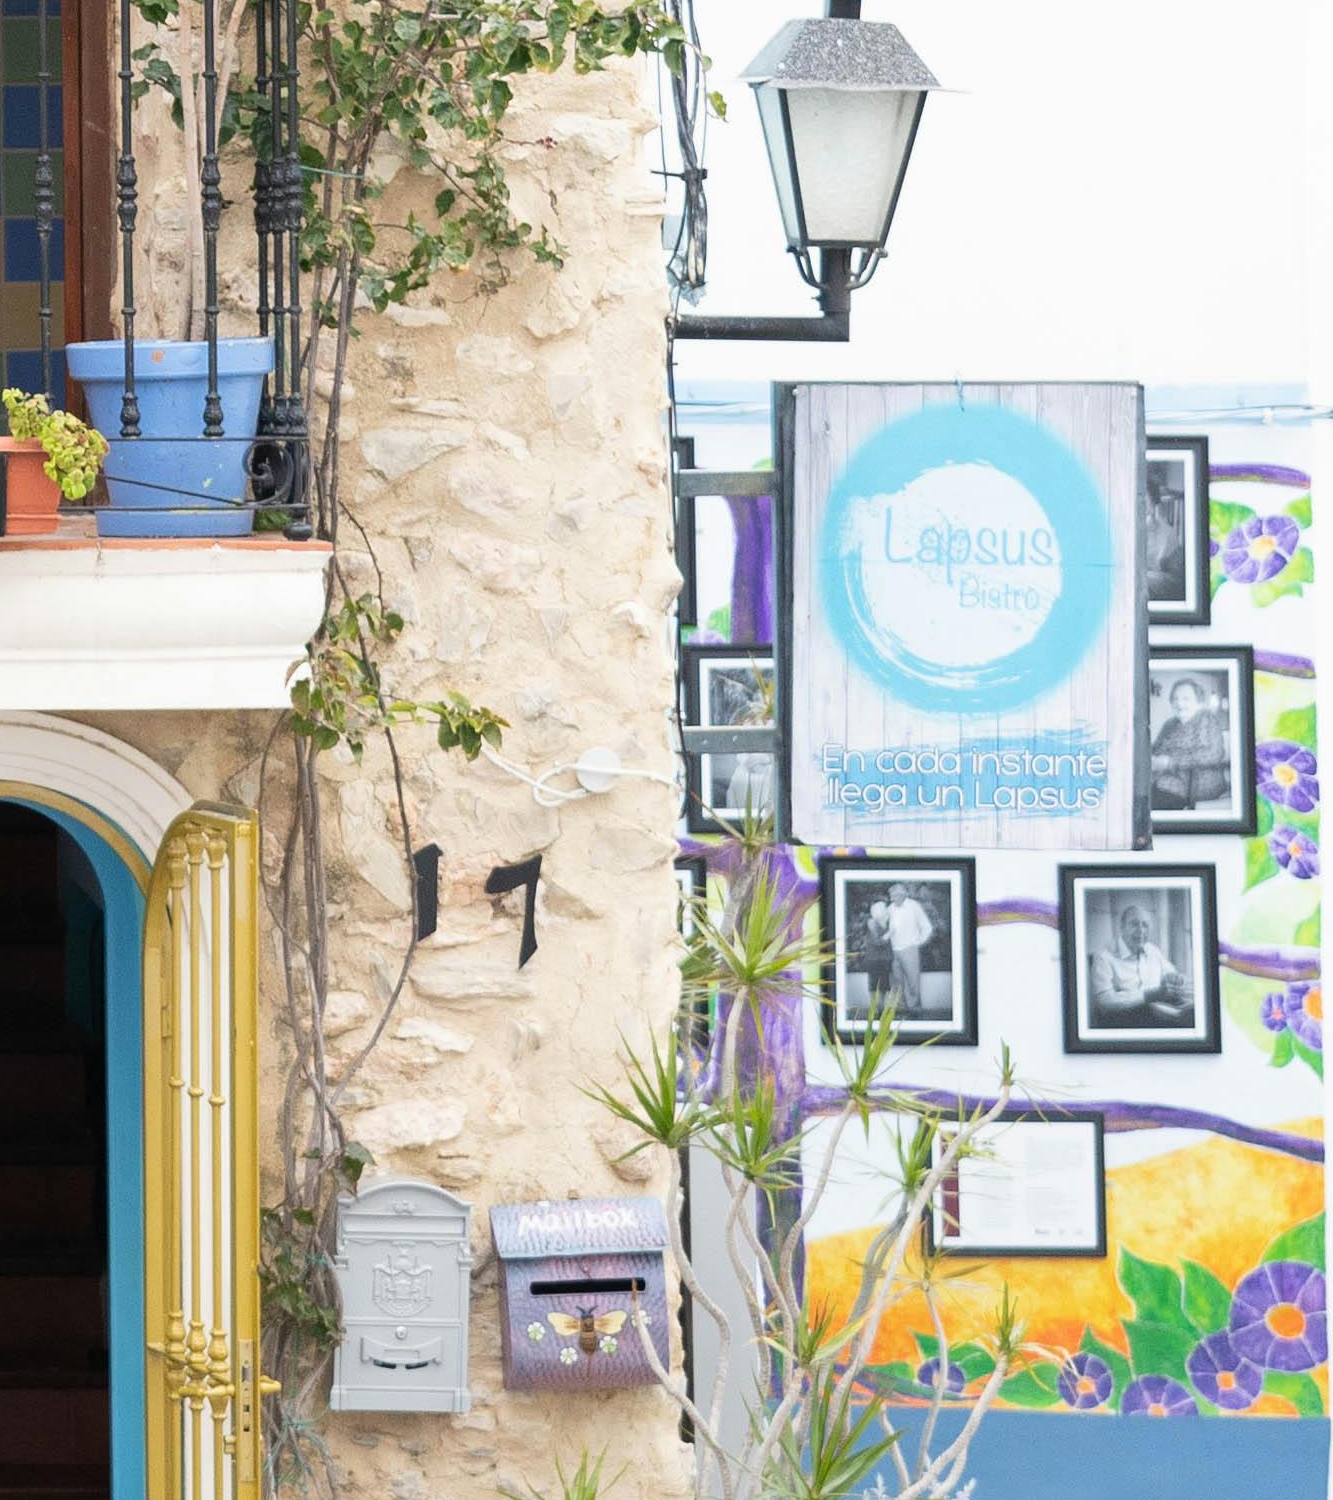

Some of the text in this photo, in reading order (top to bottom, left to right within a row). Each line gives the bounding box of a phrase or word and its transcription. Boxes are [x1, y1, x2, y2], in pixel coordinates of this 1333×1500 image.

[885, 506, 1054, 587] Lapsus
[822, 743, 1107, 777] En cada instante
[829, 777, 1100, 814] llega un Lapsus
[414, 843, 542, 969] 17
[518, 1207, 639, 1236] Mailbox
